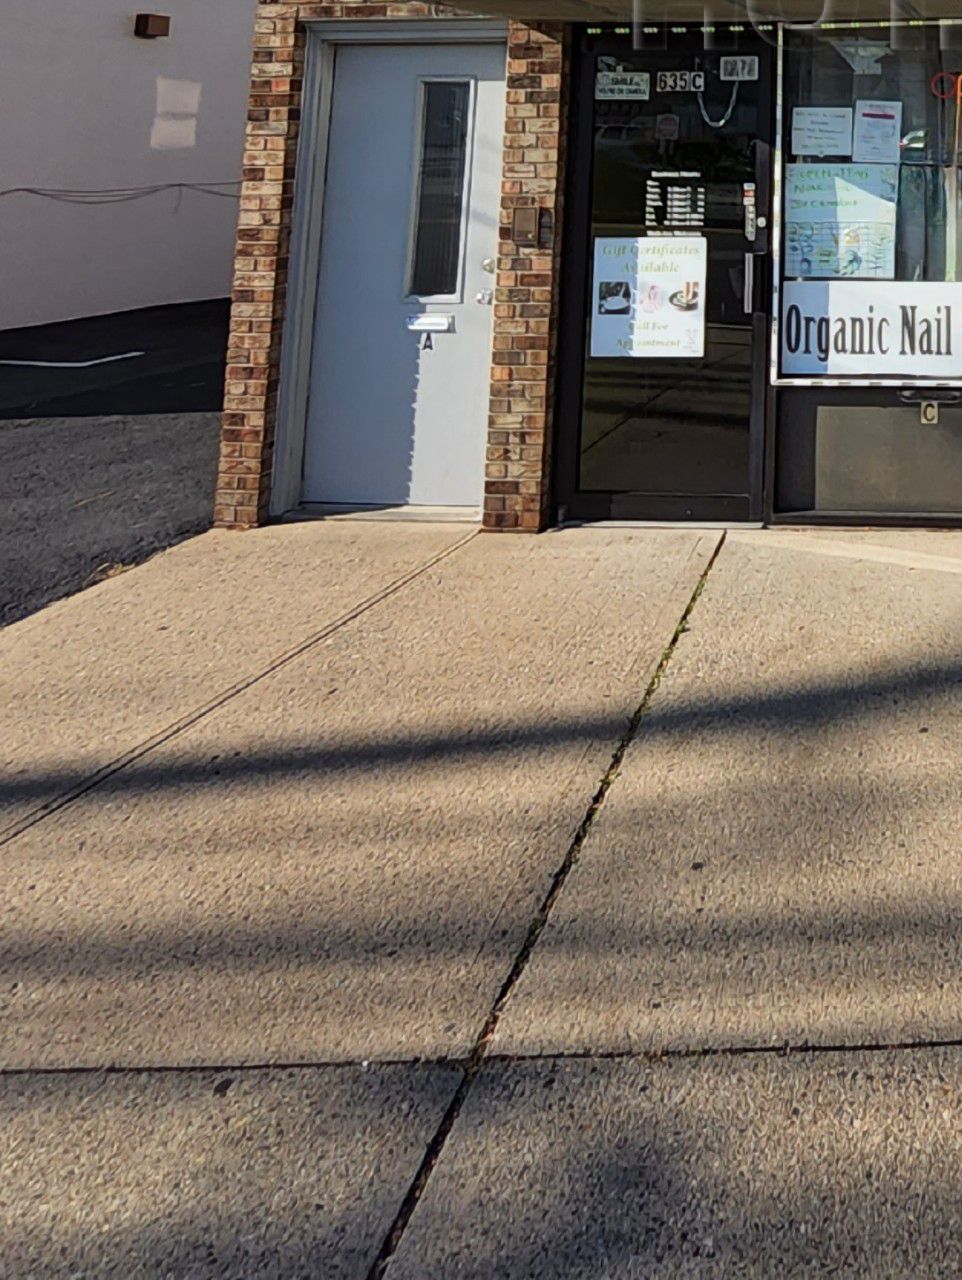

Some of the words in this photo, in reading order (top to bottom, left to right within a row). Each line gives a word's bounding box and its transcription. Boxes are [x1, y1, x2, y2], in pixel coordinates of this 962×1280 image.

[602, 244, 627, 258] Gift
[421, 331, 433, 351] A
[786, 304, 890, 362] Organic
[899, 304, 952, 356] Nail
[923, 403, 935, 422] C
